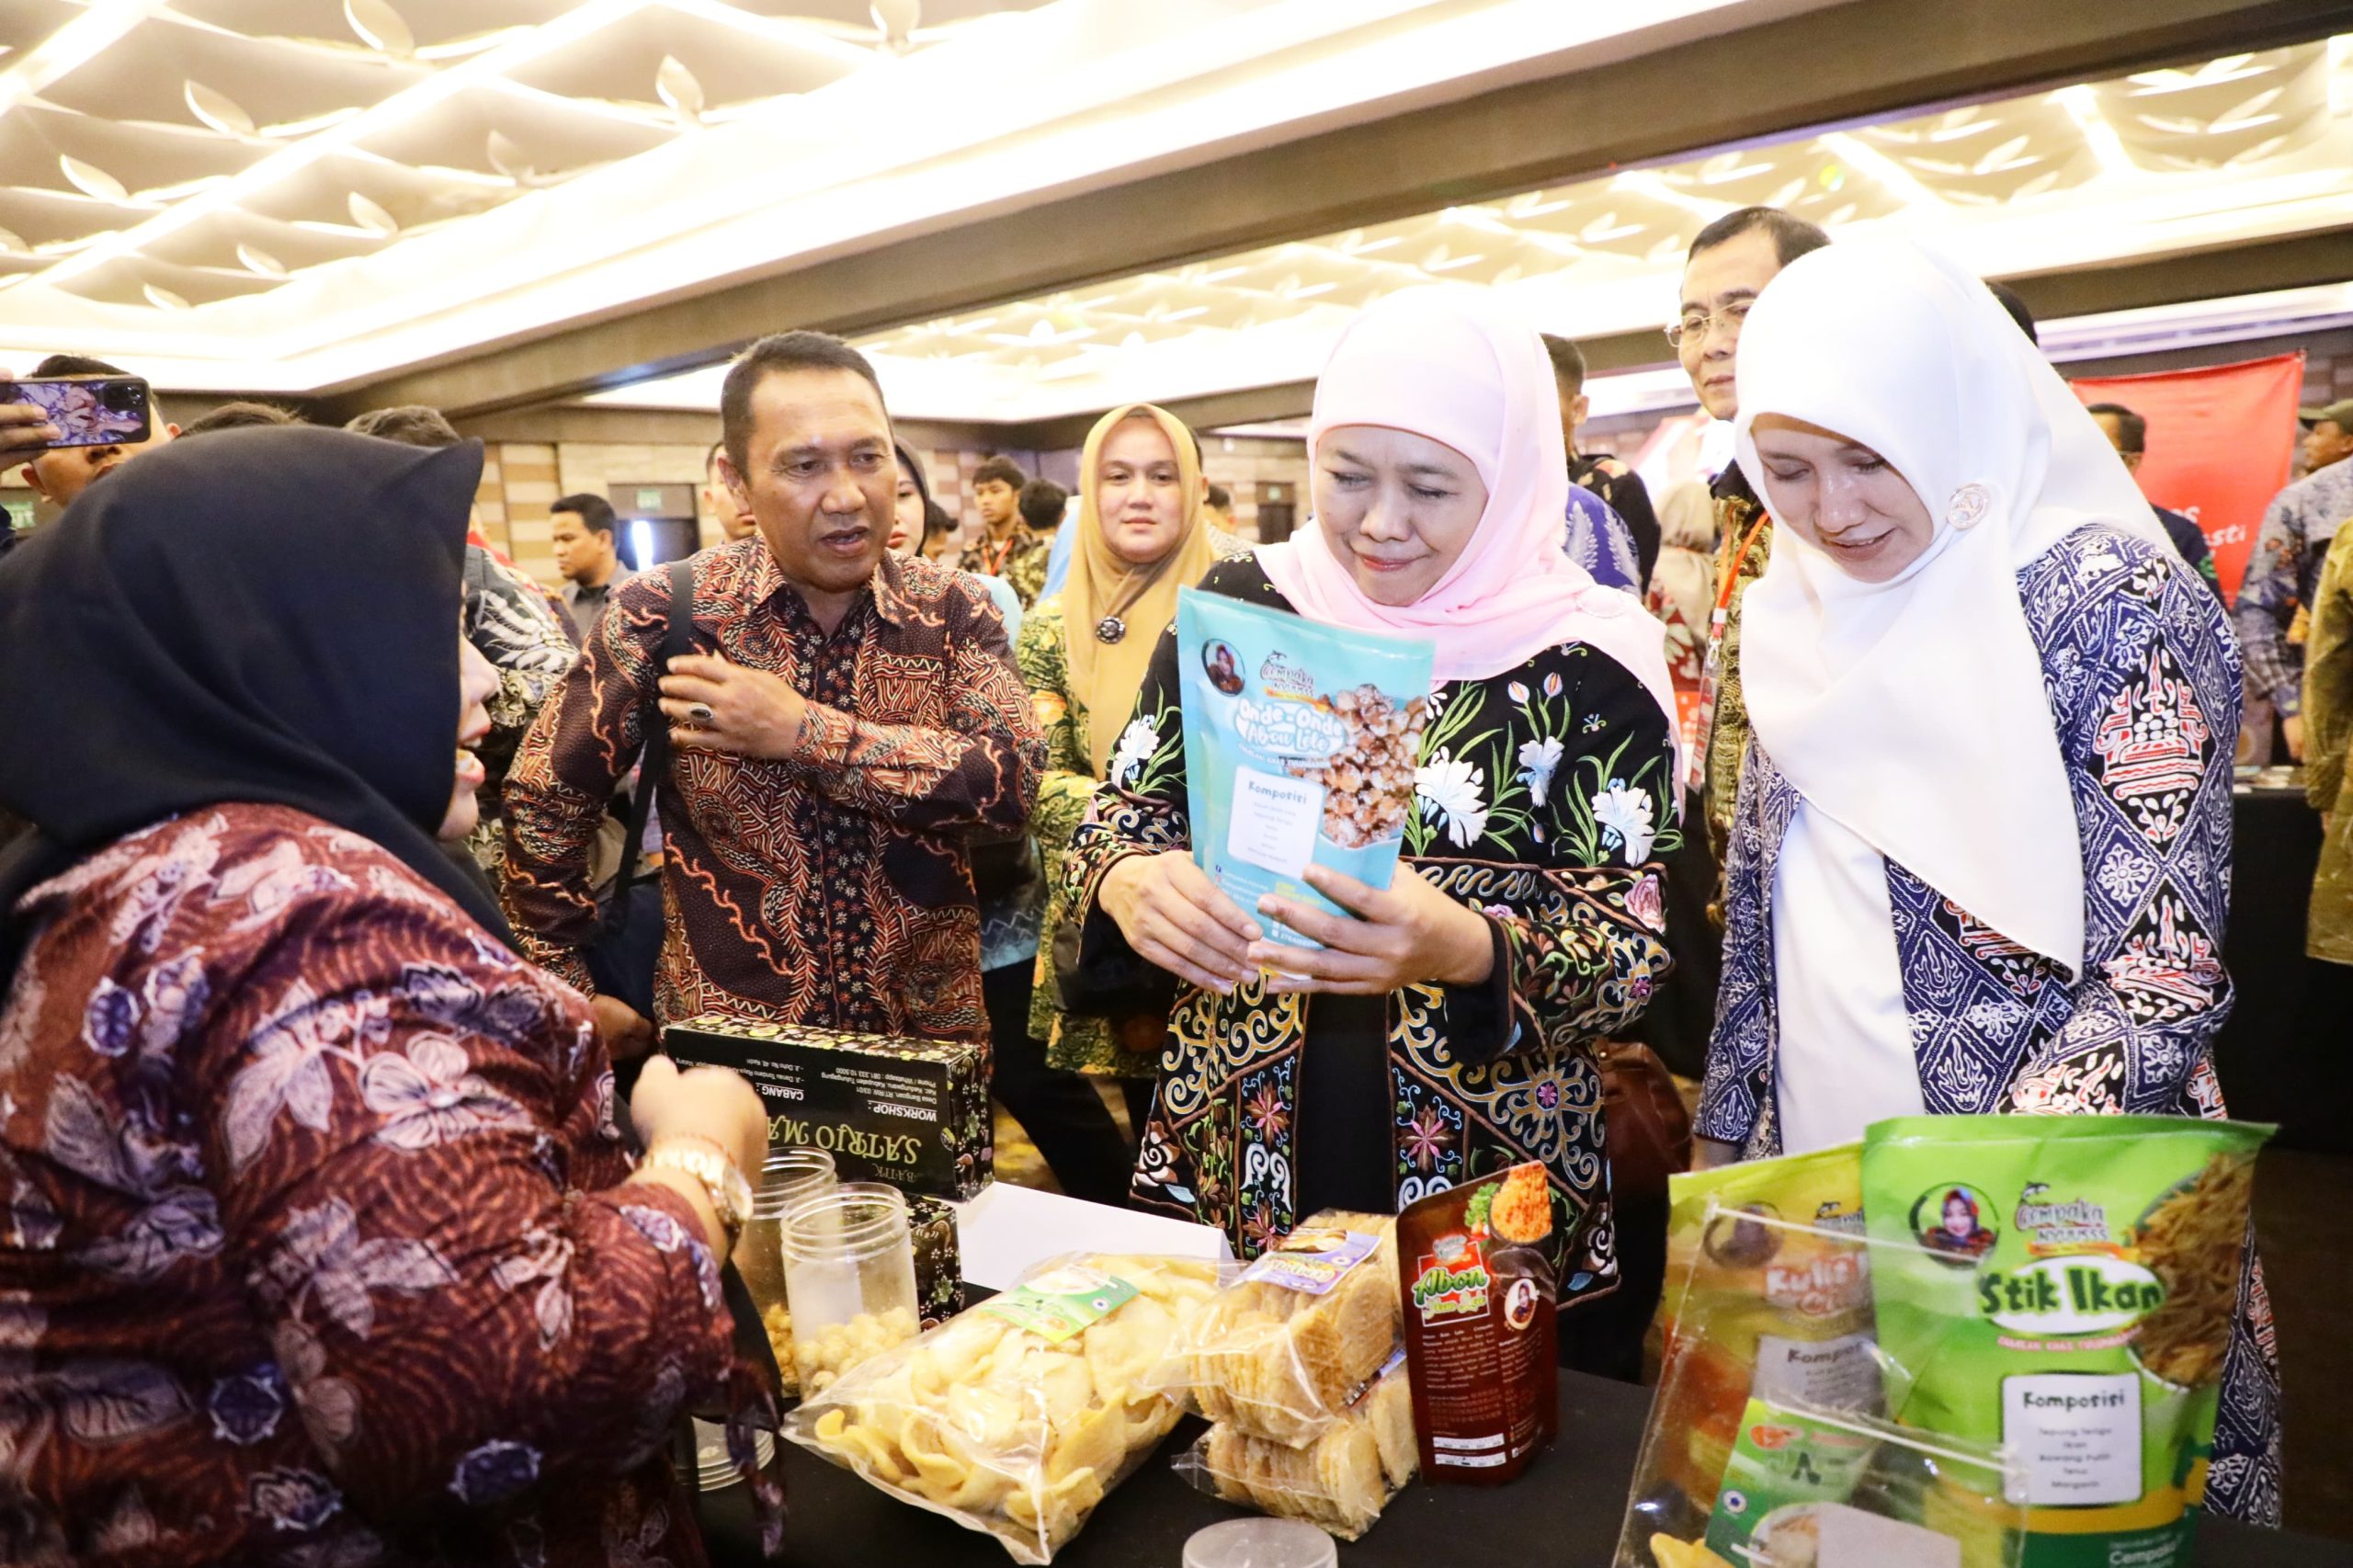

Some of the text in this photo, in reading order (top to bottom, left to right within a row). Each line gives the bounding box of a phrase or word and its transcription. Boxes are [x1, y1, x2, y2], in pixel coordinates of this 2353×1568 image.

[1248, 780, 1308, 805] Komposisi
[761, 1085, 804, 1101] CABANG
[873, 1104, 938, 1122] WORKSHOP
[767, 1114, 922, 1165] SATRIO MA
[871, 1163, 917, 1183] BATIK
[1414, 1267, 1489, 1307] Abon
[1980, 1267, 2162, 1314] Stik Ikan
[2023, 1389, 2125, 1412] Komposisi
